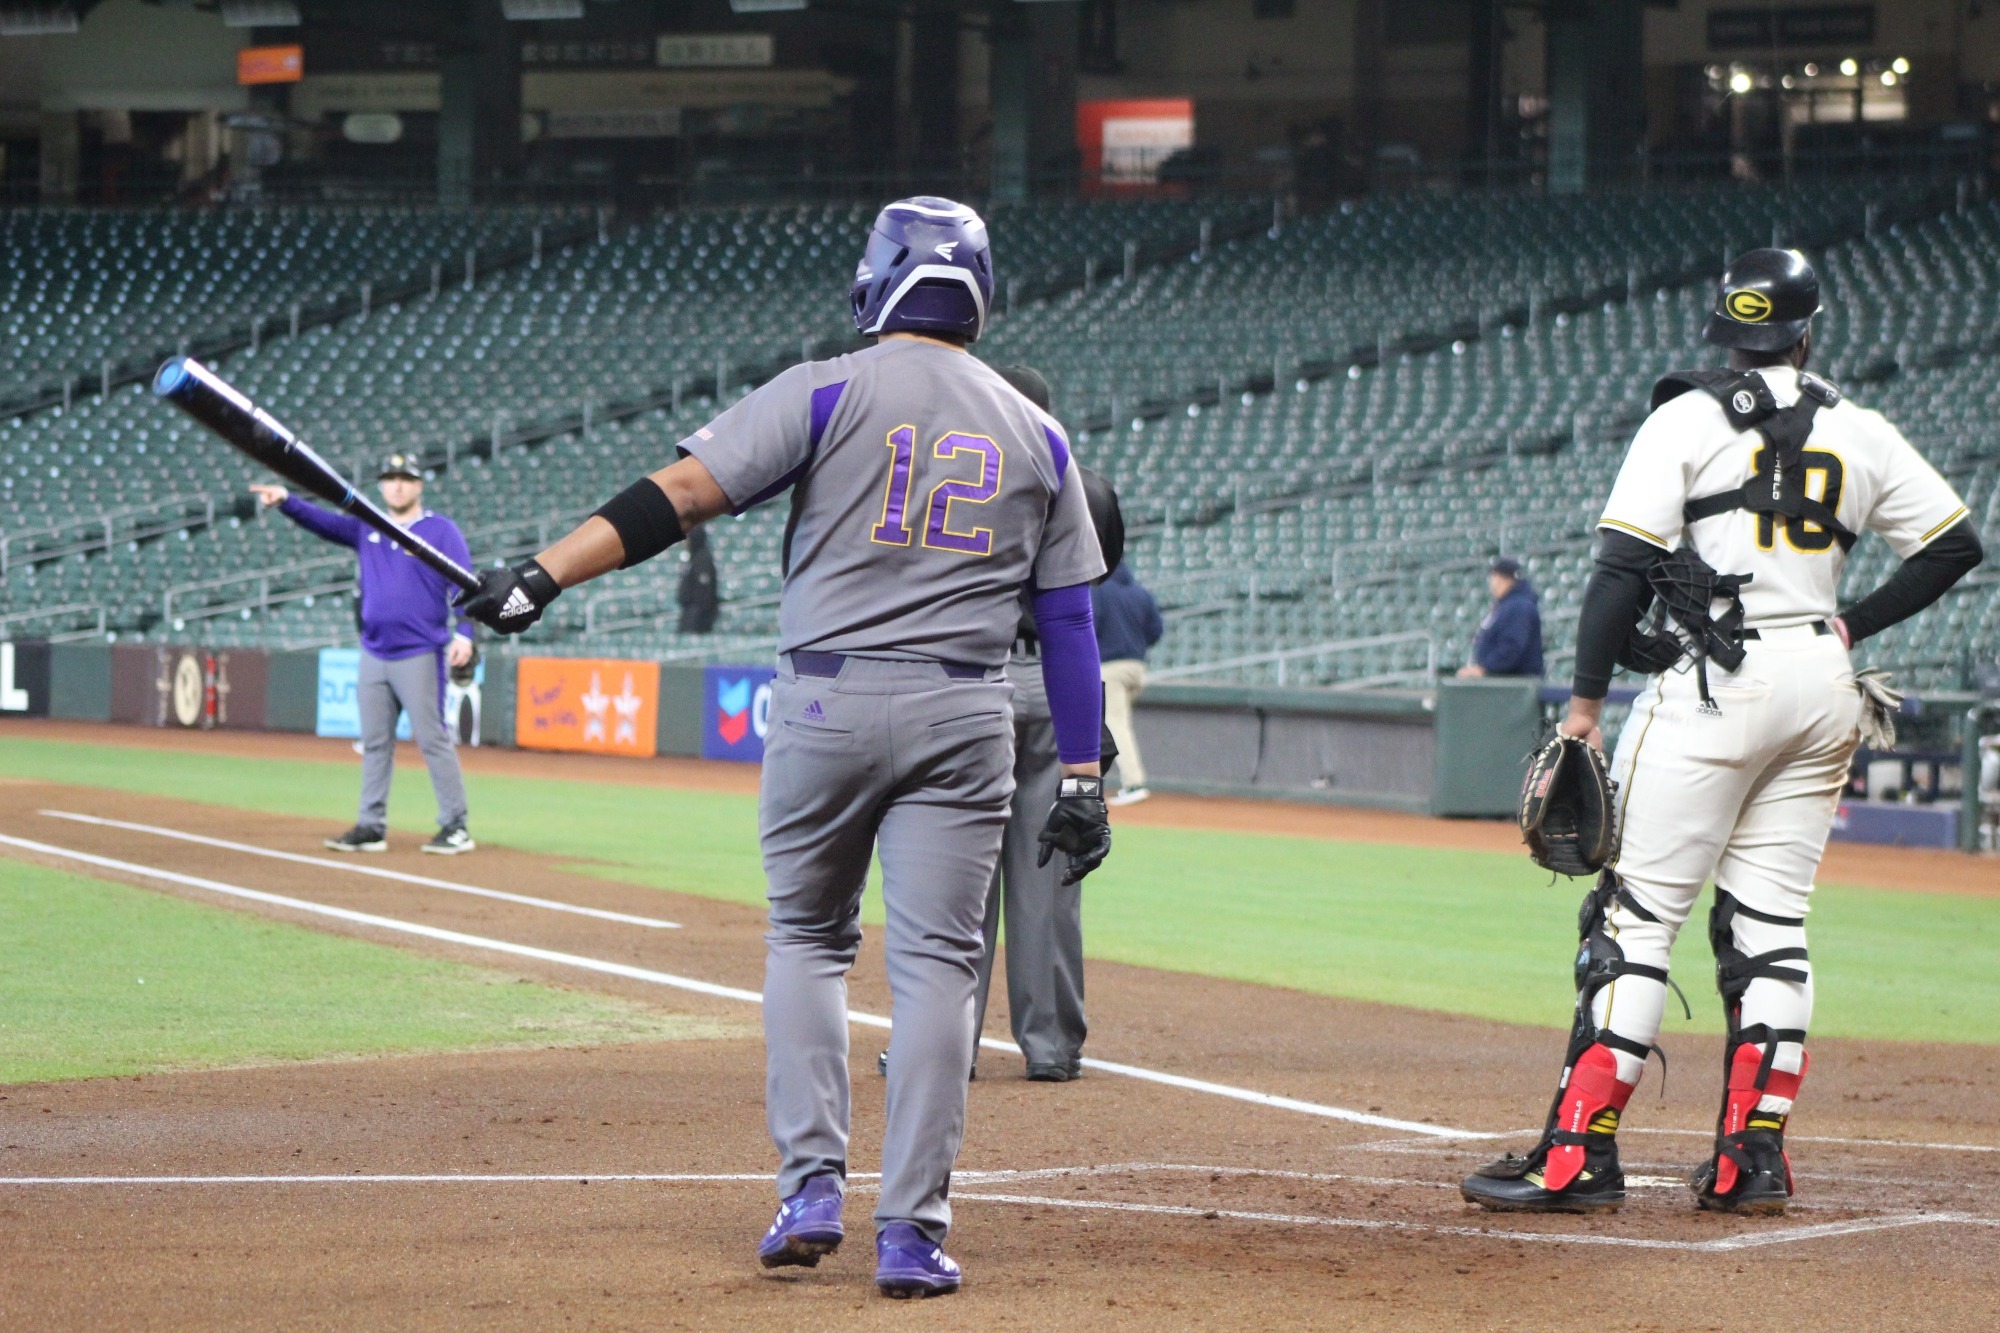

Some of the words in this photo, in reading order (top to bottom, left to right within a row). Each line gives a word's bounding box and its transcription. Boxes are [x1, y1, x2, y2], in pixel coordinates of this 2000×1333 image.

[521, 43, 649, 63] EGENDS
[871, 424, 1003, 556] 12
[1773, 451, 1782, 500] HIELD
[499, 603, 535, 619] adidas
